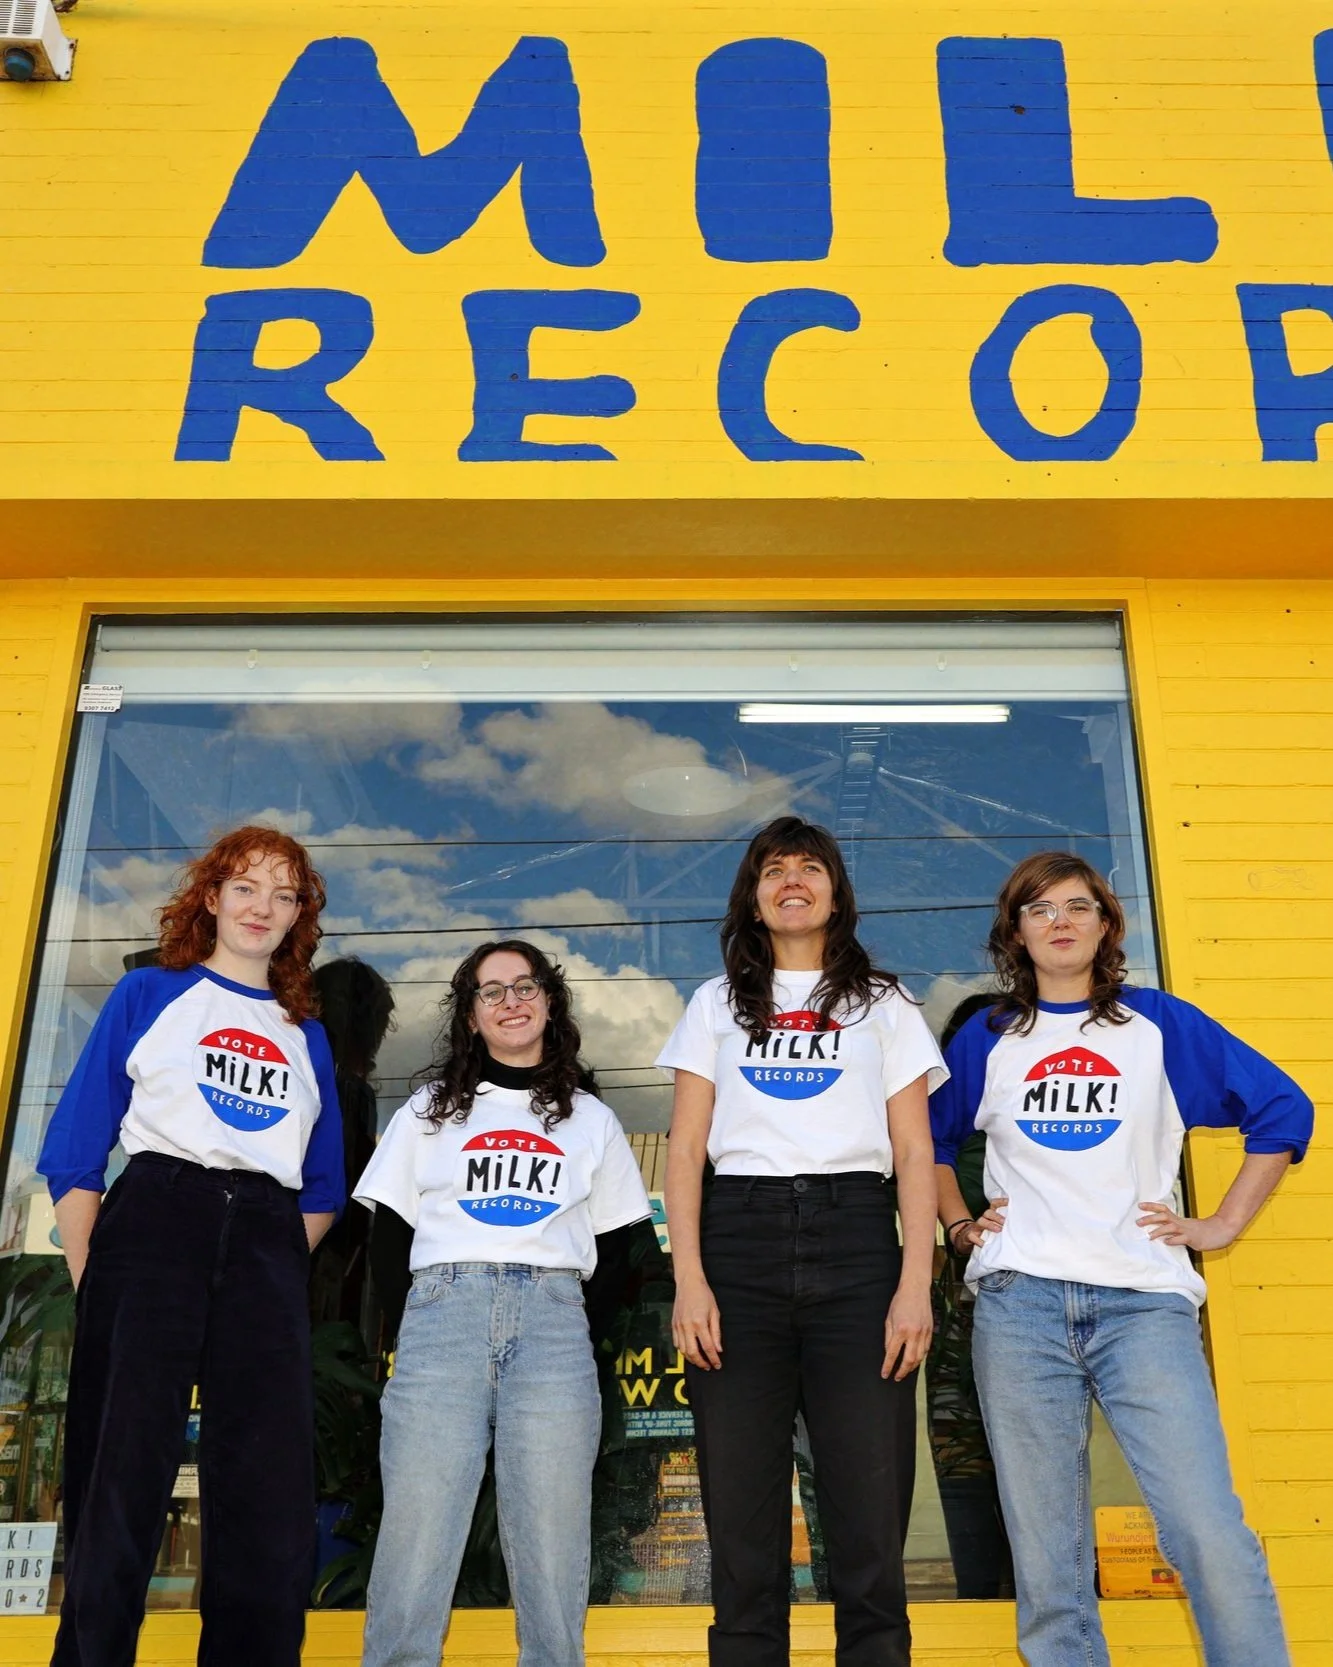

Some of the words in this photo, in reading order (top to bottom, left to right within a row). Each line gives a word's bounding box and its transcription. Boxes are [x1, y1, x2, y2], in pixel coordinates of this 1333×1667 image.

[201, 29, 1333, 268] MIL
[218, 1035, 267, 1057] VOTE
[1044, 1058, 1094, 1074] VOTE
[754, 1070, 825, 1082] RECORDS
[211, 1091, 271, 1119] RECORDS
[1031, 1123, 1103, 1134] RECORDS
[484, 1136, 538, 1150] VOTE
[471, 1198, 542, 1213] RECORDS
